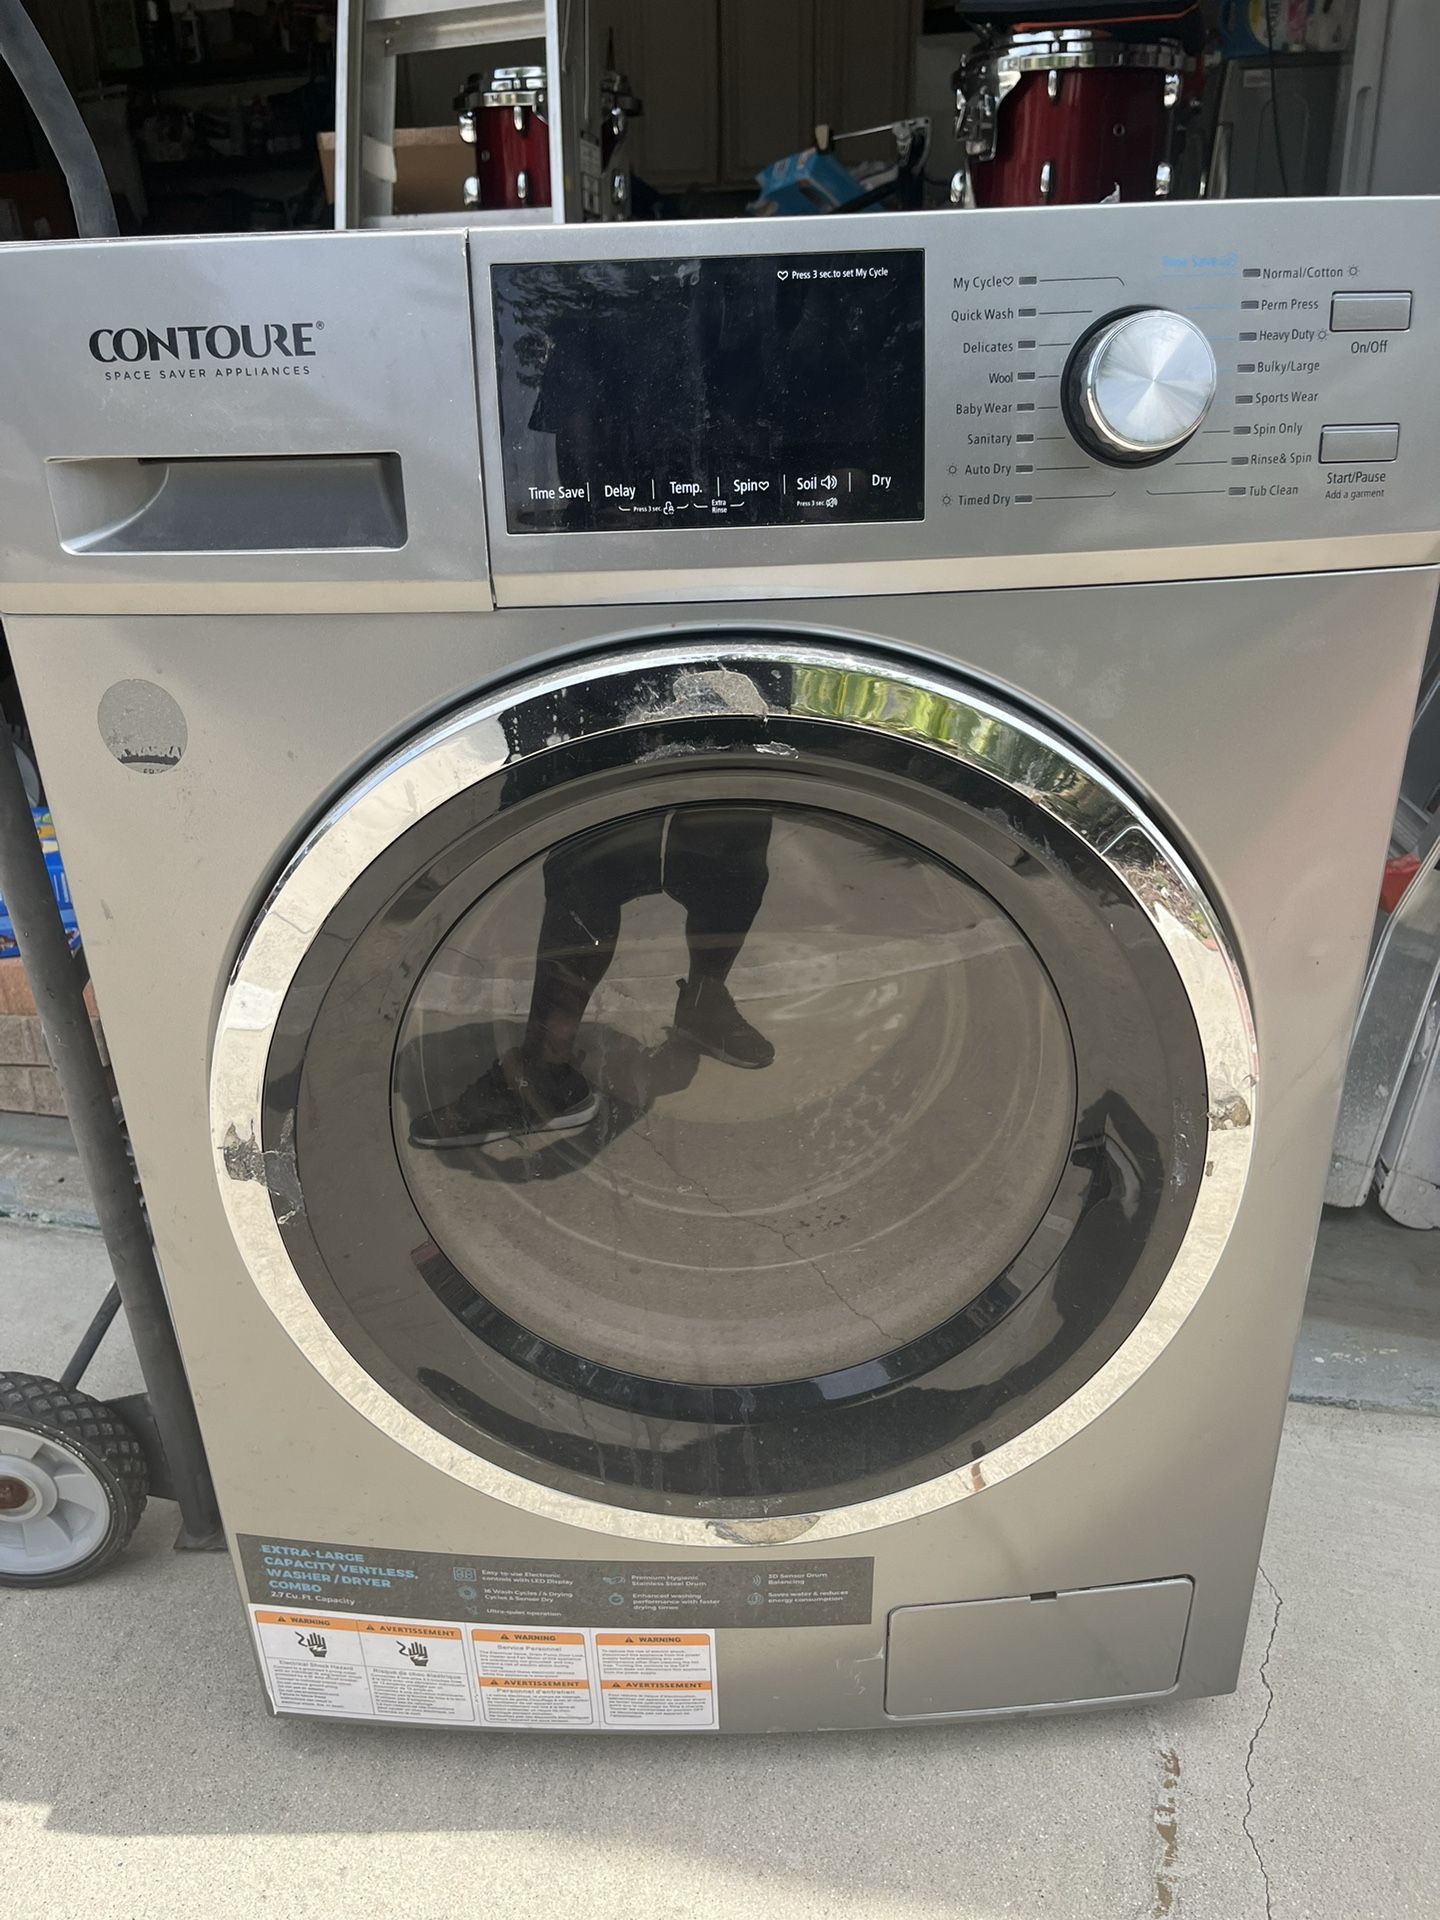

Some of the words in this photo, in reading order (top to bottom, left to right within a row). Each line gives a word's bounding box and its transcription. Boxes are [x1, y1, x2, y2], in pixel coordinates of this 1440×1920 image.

[792, 270, 811, 279] Press
[812, 269, 817, 279] 3
[842, 269, 854, 278] set
[855, 268, 867, 279] My
[868, 267, 889, 278] Cycle
[1263, 267, 1344, 280] Normal/Cotton
[953, 277, 970, 292] My
[973, 276, 1002, 291] Cycle
[1261, 300, 1288, 310] Perm
[1290, 299, 1320, 310] Press
[951, 309, 982, 323] Quick
[984, 308, 1014, 320] Wash
[1259, 330, 1290, 343] Heavy
[1292, 328, 1315, 342] Duty
[963, 342, 1014, 354] Delicates
[1351, 340, 1389, 354] On/Off
[105, 370, 151, 381] SPACE
[159, 368, 206, 379] SAVER
[215, 366, 310, 377] APPLIANCES
[1257, 360, 1320, 374] Bulky/Large
[989, 372, 1014, 384] Wool
[1255, 392, 1289, 406] Sports
[1291, 391, 1319, 402] Wear
[956, 403, 982, 417] Baby
[984, 403, 1013, 414] Wear
[1253, 424, 1276, 436] Spin
[1279, 422, 1304, 436] Only
[967, 434, 1012, 446] Sanitary
[1290, 452, 1312, 466] Spin
[965, 464, 991, 475] Auto
[993, 463, 1011, 476] Dry
[797, 476, 817, 490] Soil
[872, 474, 892, 488] Dry
[1327, 471, 1386, 484] Start/Pause
[529, 487, 555, 500] Time
[558, 486, 584, 499] Save
[604, 484, 636, 500] Delay
[669, 481, 703, 496] Temp.
[733, 478, 758, 495] Spin
[1250, 485, 1267, 496] Tub
[1270, 484, 1298, 496] Clean
[959, 494, 991, 506] Timed
[993, 494, 1011, 507] Dry
[1325, 491, 1342, 500] Add
[1343, 492, 1348, 500] a
[1350, 489, 1385, 501] garment
[712, 506, 727, 514] Rinse
[261, 1544, 365, 1563] EXTRA-LARGE
[264, 1556, 336, 1572] CAPACITY
[266, 1568, 331, 1584] WASHER
[334, 1574, 339, 1584] /
[342, 1575, 392, 1588] DRYER
[268, 1580, 322, 1593] COMBO
[315, 1595, 356, 1606] Capacity
[290, 1617, 331, 1626] WARNING
[380, 1625, 456, 1637] AVERTISSEMENT
